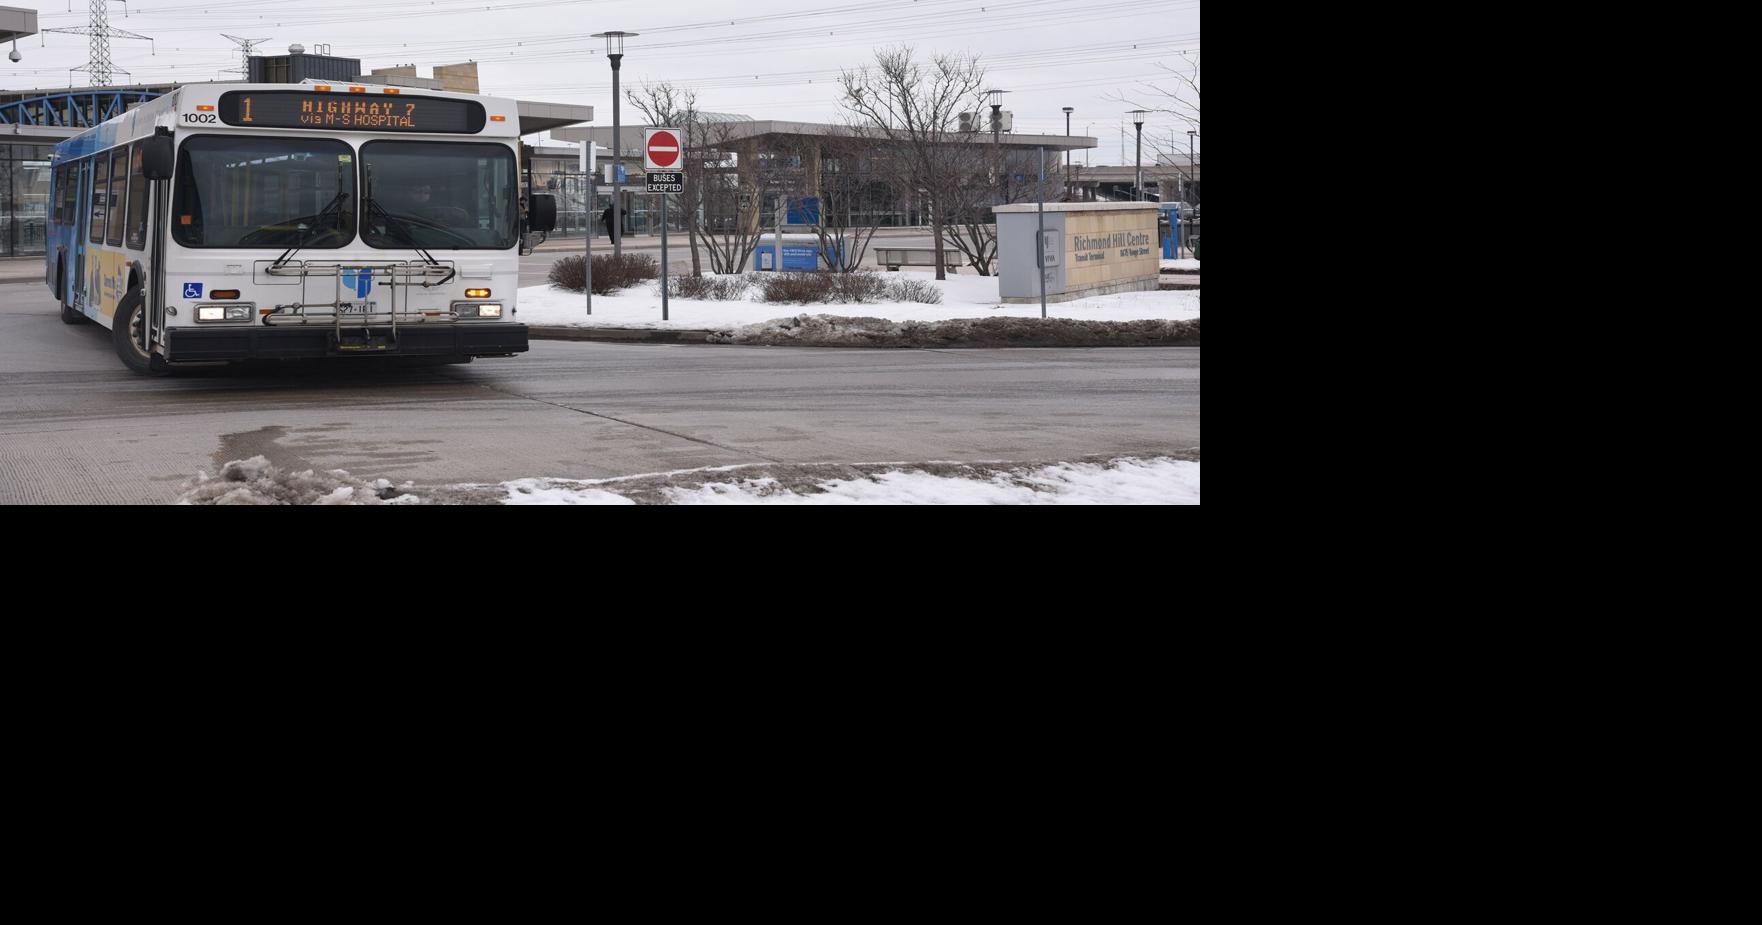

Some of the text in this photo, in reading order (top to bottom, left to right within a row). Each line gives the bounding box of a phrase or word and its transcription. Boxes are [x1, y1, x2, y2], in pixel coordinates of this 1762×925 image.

[242, 96, 253, 122] 1
[302, 101, 416, 116] HIGHWAY 7
[183, 113, 217, 124] 1002
[326, 114, 351, 125] M-S
[354, 114, 416, 127] HOSPITAL
[1075, 235, 1110, 251] Richmond
[1112, 232, 1126, 248] Hill
[1127, 232, 1149, 246] Centre
